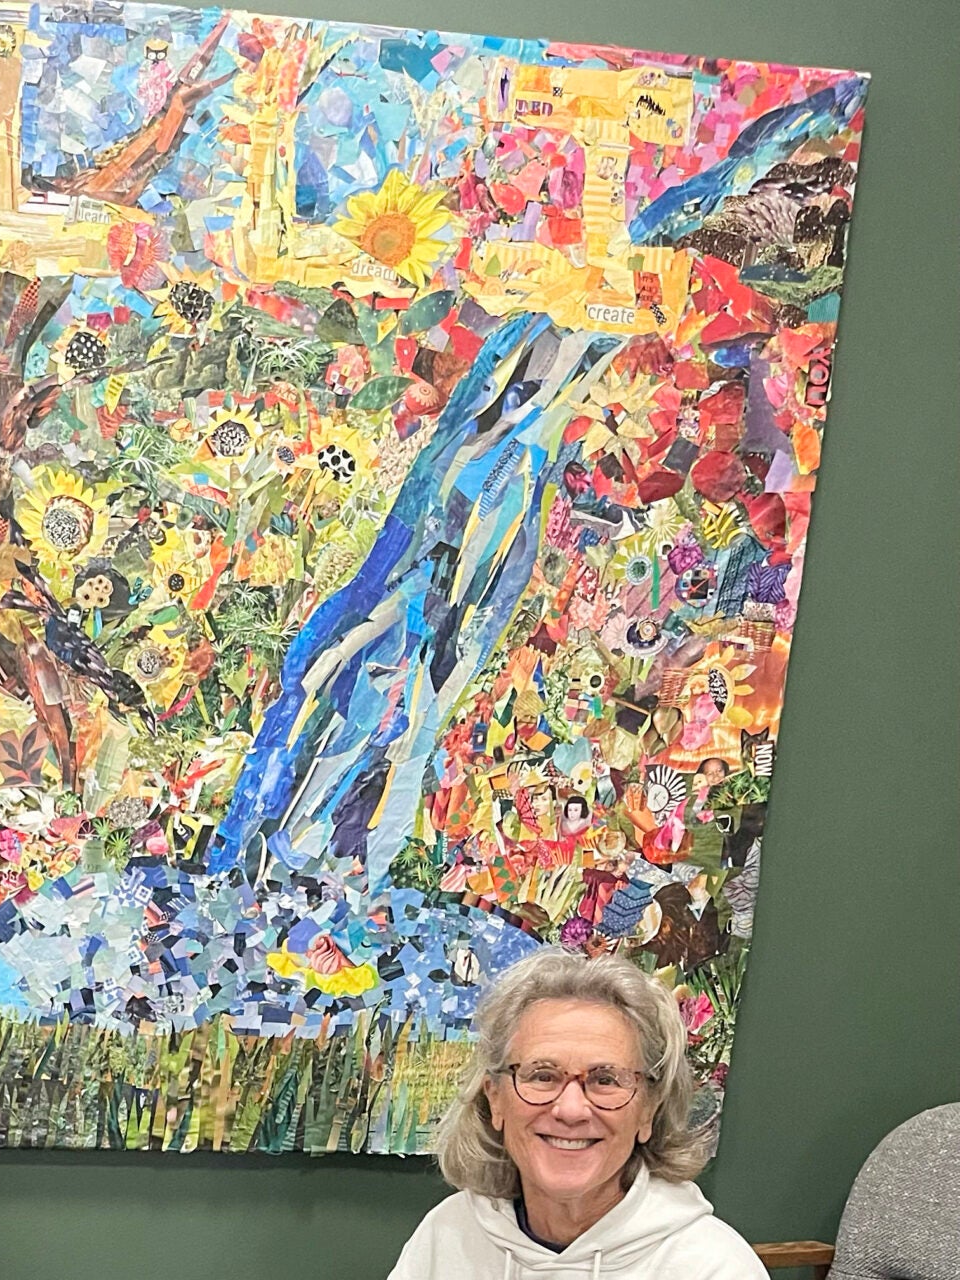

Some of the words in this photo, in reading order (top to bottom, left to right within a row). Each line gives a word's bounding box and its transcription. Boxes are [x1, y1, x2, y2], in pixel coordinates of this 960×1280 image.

[351, 257, 397, 280] dream
[587, 305, 635, 324] create
[806, 347, 831, 406] YOU
[754, 744, 773, 776] NOW
